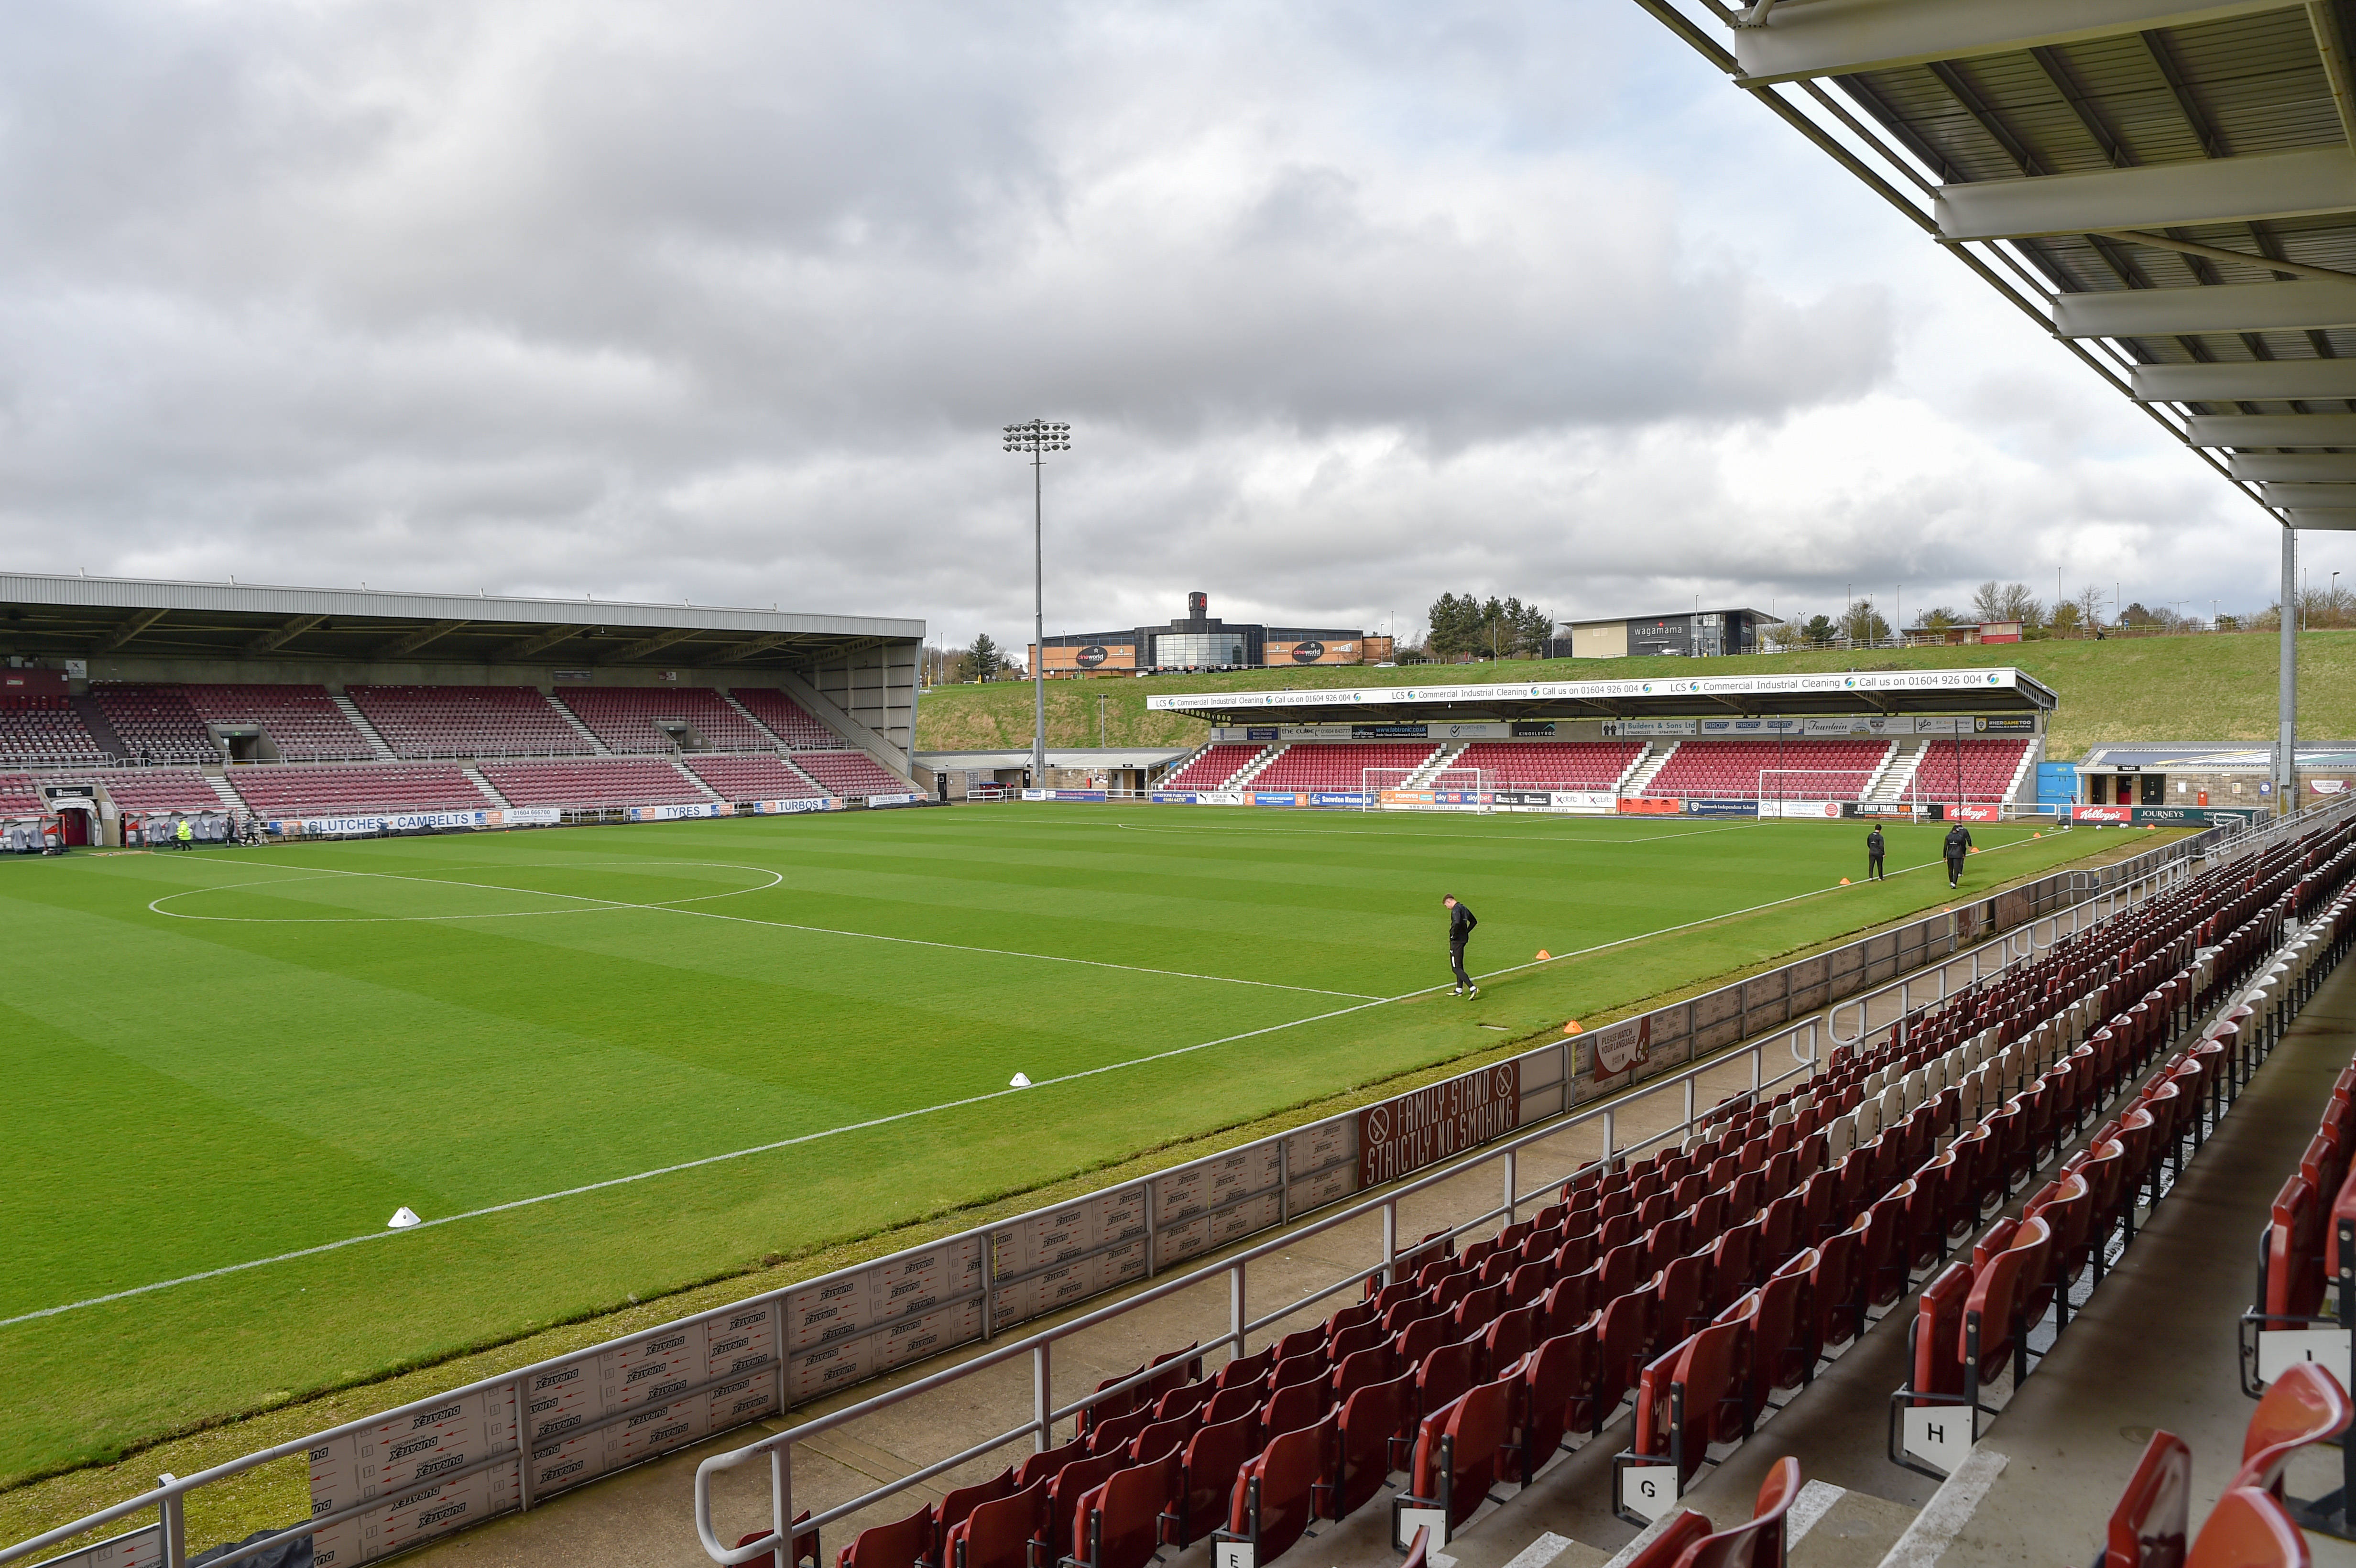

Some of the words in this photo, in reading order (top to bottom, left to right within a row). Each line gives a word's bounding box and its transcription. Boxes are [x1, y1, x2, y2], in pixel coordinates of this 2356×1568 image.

[1635, 626, 1682, 636] wagamama
[1670, 683, 1686, 692] LCS
[1703, 681, 1752, 691] Commercial
[1757, 680, 1798, 689] Industrial
[1802, 679, 1840, 689] Cleaning
[1859, 677, 1876, 686] Call
[1909, 676, 1938, 685] 01604
[1942, 675, 1960, 685] 926
[1963, 675, 1982, 684] 004
[1418, 690, 1457, 698] Commercial
[1461, 688, 1493, 697] Industrial
[1497, 688, 1527, 697] Cleaning
[1542, 687, 1556, 695] Call
[1177, 698, 1208, 706] Commercial
[1239, 697, 1263, 705] Cleaning
[1809, 720, 1847, 730] Fountain
[779, 800, 818, 810] TURBOS
[1436, 794, 1447, 802] sky
[1466, 794, 1478, 802] sky
[665, 806, 700, 817] TYRES
[2080, 808, 2123, 821] Kellogg's
[2140, 810, 2184, 819] JOURNEYS
[309, 818, 385, 832] CLUTCHES
[397, 814, 469, 827] CAMBELTS
[1601, 1044, 1613, 1055] YOUR
[1614, 1035, 1636, 1050] LANGUAGE
[1602, 1033, 1617, 1045] PLEASE
[1617, 1028, 1632, 1040] WATCH
[1397, 1084, 1445, 1136] FAMILY
[1451, 1069, 1489, 1116] STAND
[1367, 1126, 1431, 1185] STRICTLY
[1438, 1118, 1454, 1158] NO
[1460, 1095, 1513, 1148] SMOKING
[1119, 1191, 1142, 1205] DURATEX
[1056, 1212, 1080, 1227] DURATEX
[905, 1258, 934, 1274] DURATEX
[820, 1283, 853, 1301] DURATEX
[906, 1296, 936, 1313] DURATEX
[729, 1311, 766, 1331] DURATEX
[647, 1334, 675, 1346] ALUMABOARD
[822, 1323, 855, 1341] DURATEX
[645, 1336, 685, 1356] DURATEX
[731, 1354, 767, 1373] DURATEX
[535, 1369, 579, 1391] DURATEX
[536, 1366, 568, 1380] ALUMABOARD
[626, 1363, 666, 1383] DURATEX
[648, 1380, 687, 1400] DURATEX
[413, 1405, 461, 1430] DURATEX
[538, 1415, 581, 1437] DURATEX
[1928, 1422, 1943, 1444] H
[388, 1436, 438, 1462] DURATEX
[391, 1434, 426, 1450] ALUMABOARD
[415, 1454, 464, 1480] DURATEX
[540, 1460, 584, 1484] DURATEX
[1641, 1481, 1655, 1497] G
[418, 1502, 466, 1529] DURATEX
[420, 1501, 454, 1517] ALUMABOARD
